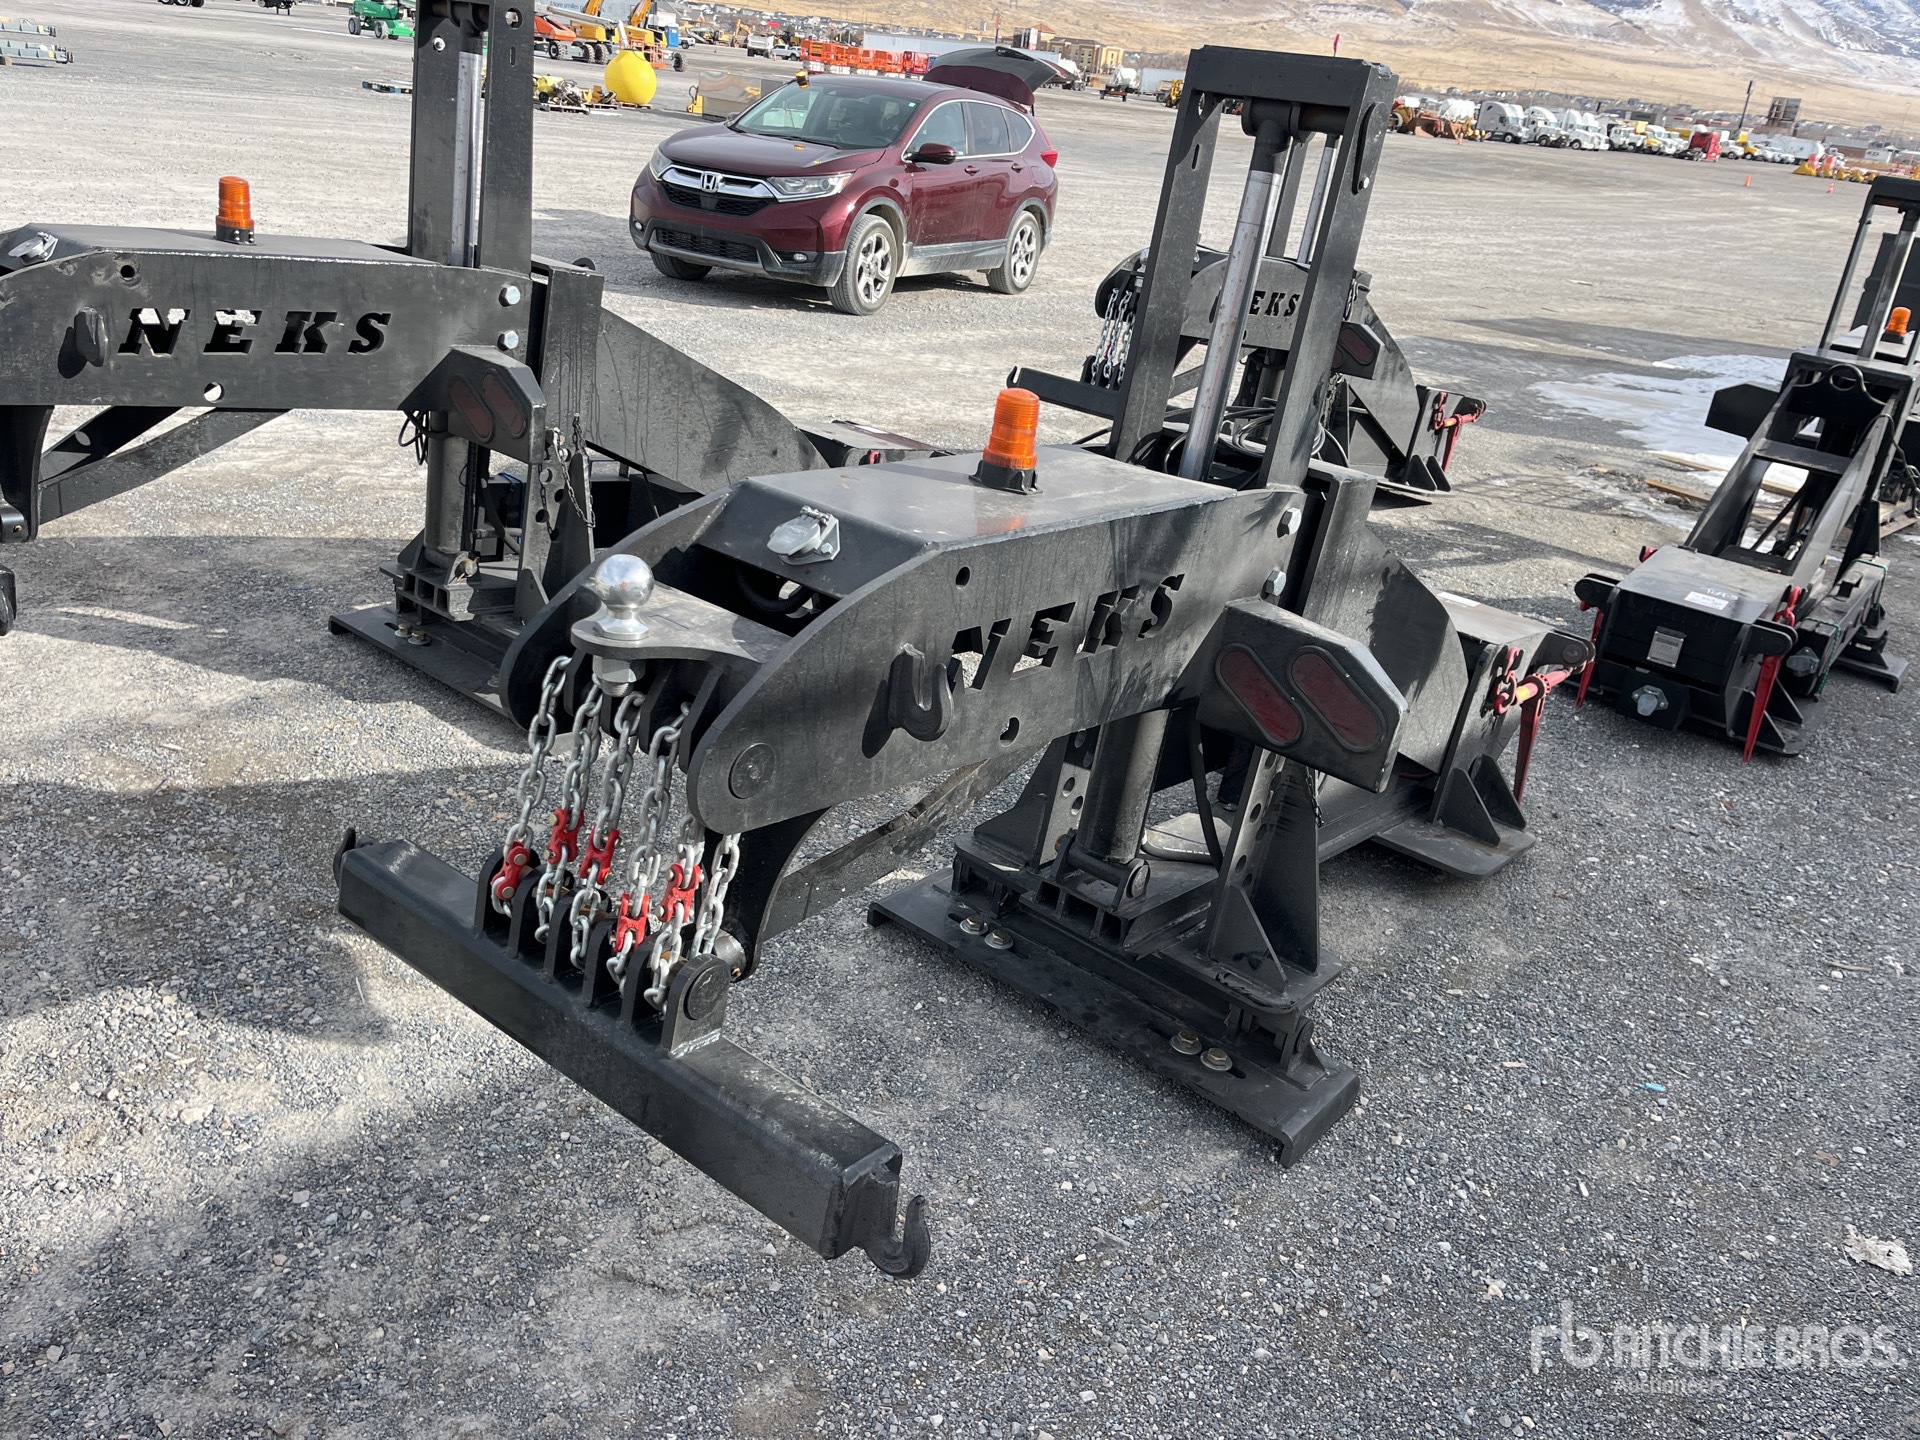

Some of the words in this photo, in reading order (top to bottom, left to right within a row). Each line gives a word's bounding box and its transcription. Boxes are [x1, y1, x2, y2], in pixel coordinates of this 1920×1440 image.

[1249, 290, 1300, 317] EKS
[117, 307, 392, 357] NEKS
[947, 573, 1186, 695] NEKS
